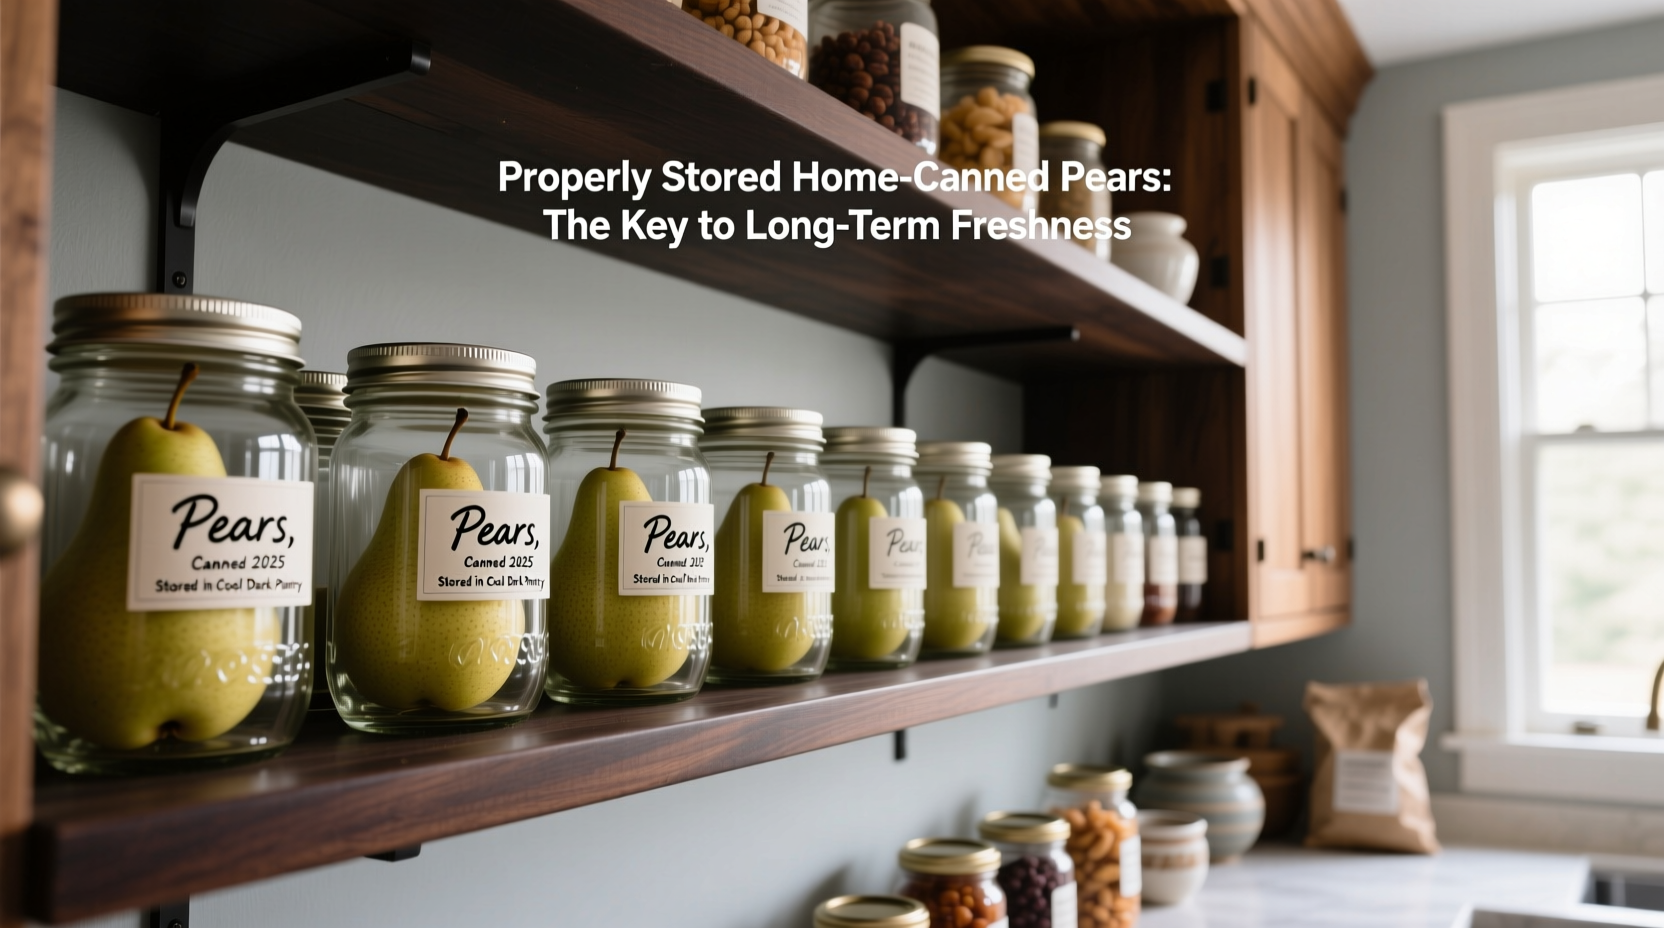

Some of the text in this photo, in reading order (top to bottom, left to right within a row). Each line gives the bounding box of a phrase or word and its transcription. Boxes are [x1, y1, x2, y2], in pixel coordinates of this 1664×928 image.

[171, 494, 295, 550] Pears,
[450, 504, 540, 552] Pears,
[643, 514, 710, 554] Pears,
[191, 555, 286, 571] Canned 2025
[464, 555, 534, 568] Canned 2025
[155, 578, 199, 593] Stored
[203, 578, 213, 591] in
[475, 575, 484, 587] in
[662, 573, 670, 584] in
